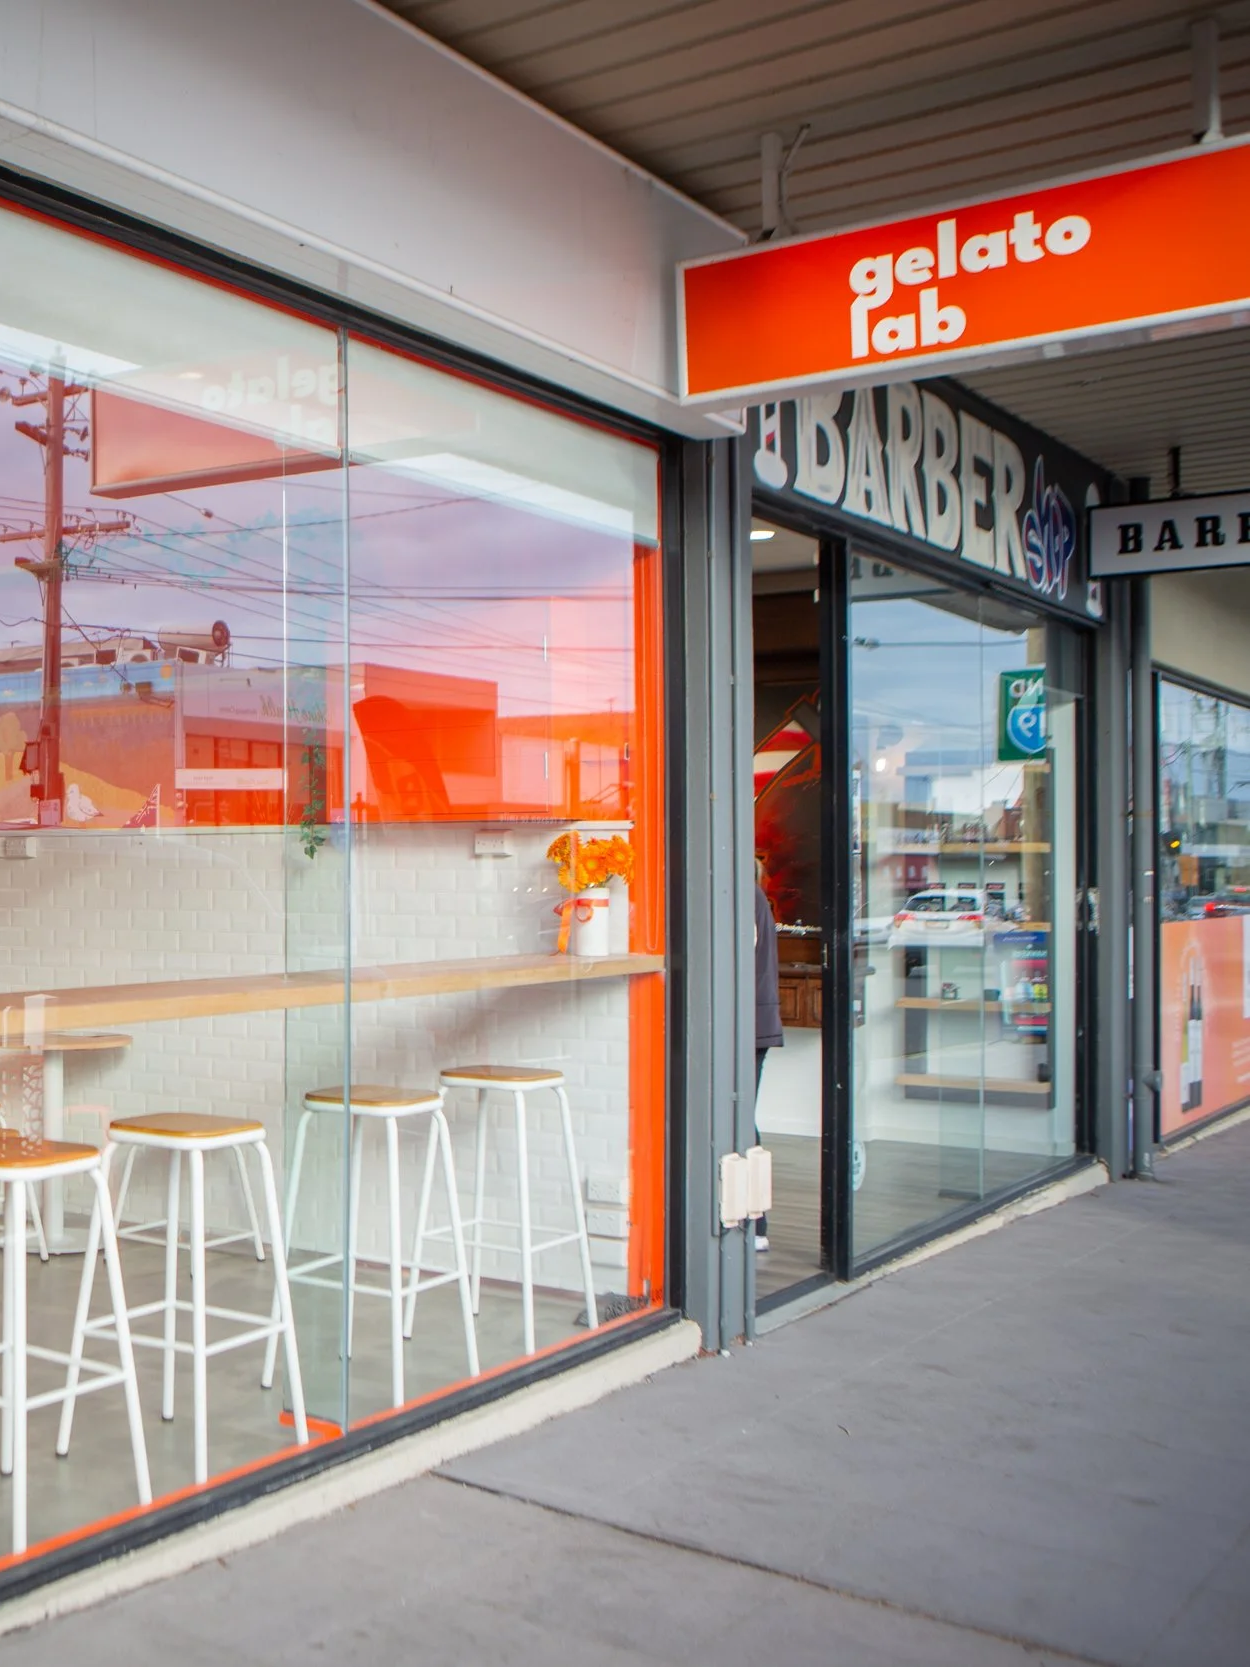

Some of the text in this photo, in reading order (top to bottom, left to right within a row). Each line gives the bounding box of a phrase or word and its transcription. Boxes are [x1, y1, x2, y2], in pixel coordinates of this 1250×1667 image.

[849, 210, 1092, 310] gelato
[851, 287, 967, 359] lab
[793, 381, 1028, 581] BARBER
